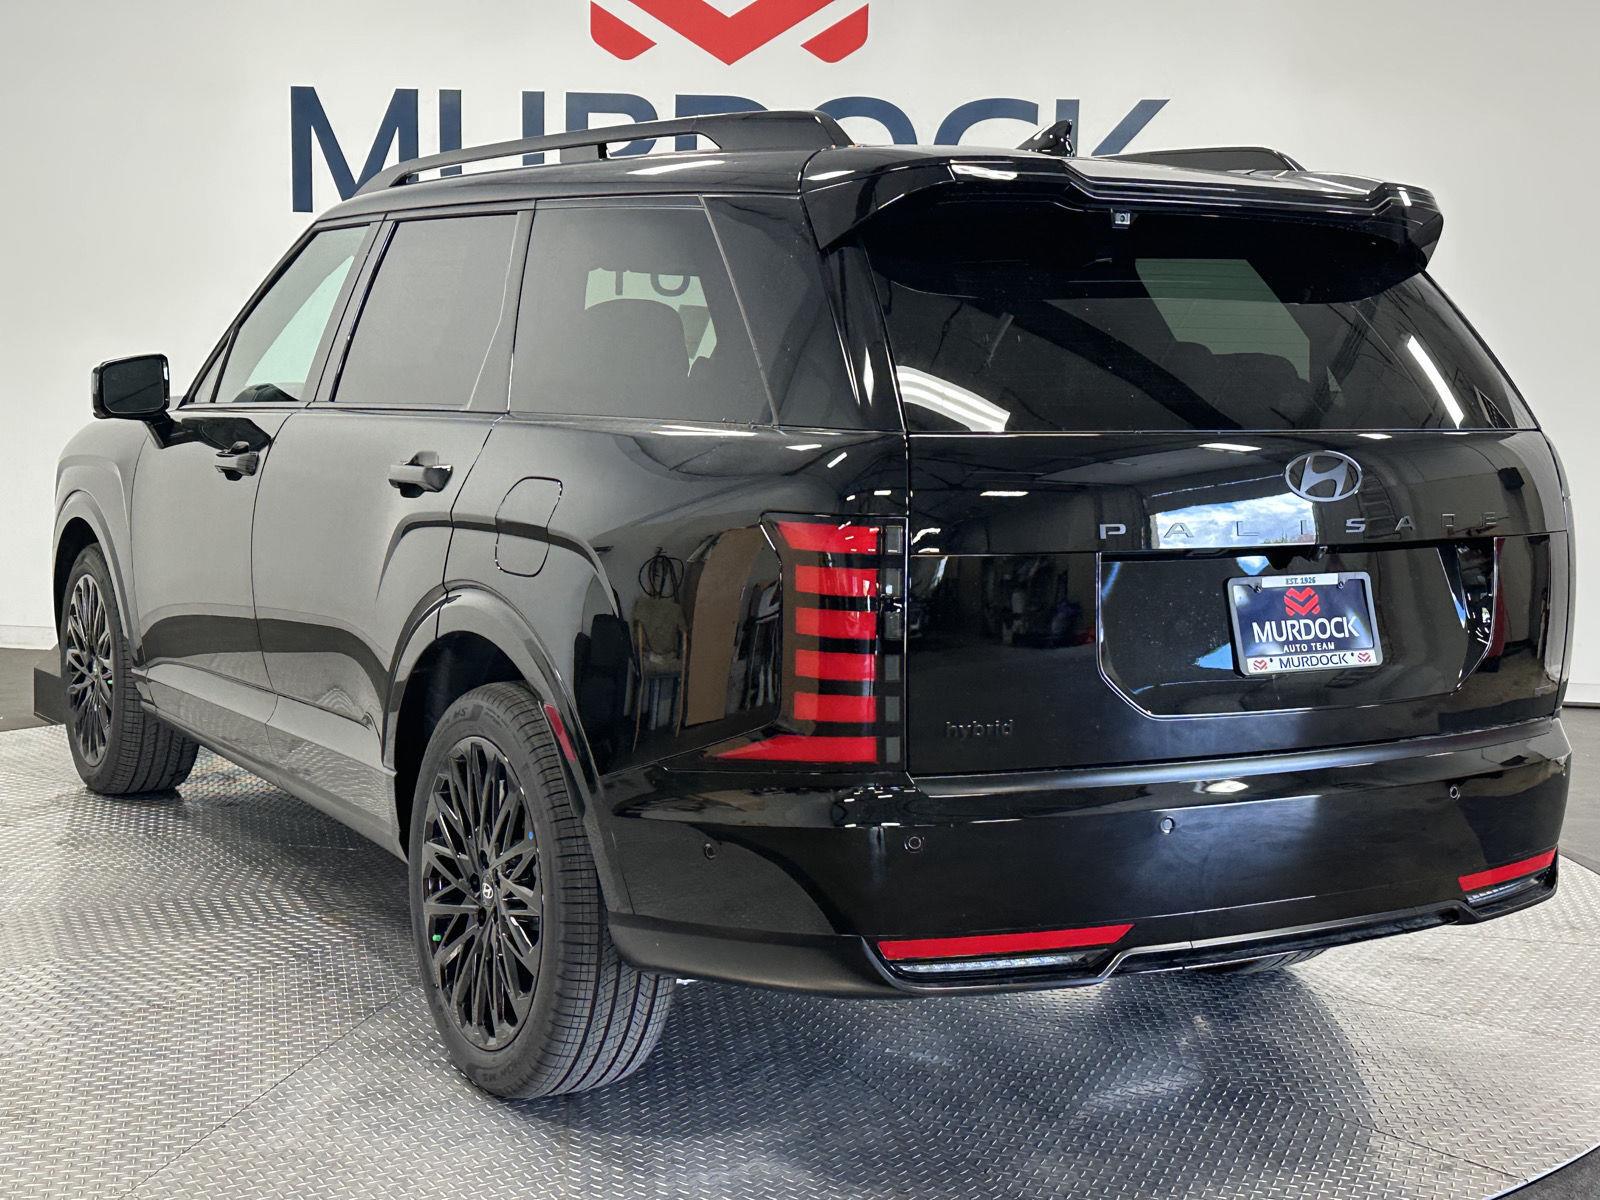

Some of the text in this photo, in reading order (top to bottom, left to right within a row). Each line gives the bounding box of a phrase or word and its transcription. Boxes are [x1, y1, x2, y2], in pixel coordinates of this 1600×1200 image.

[1100, 511, 1497, 540] PALISADE
[1252, 616, 1359, 642] MURDOCK
[1283, 642, 1335, 653] AUTO TEAM
[1279, 653, 1349, 669] MURDOCK
[946, 719, 1013, 740] hybrid
